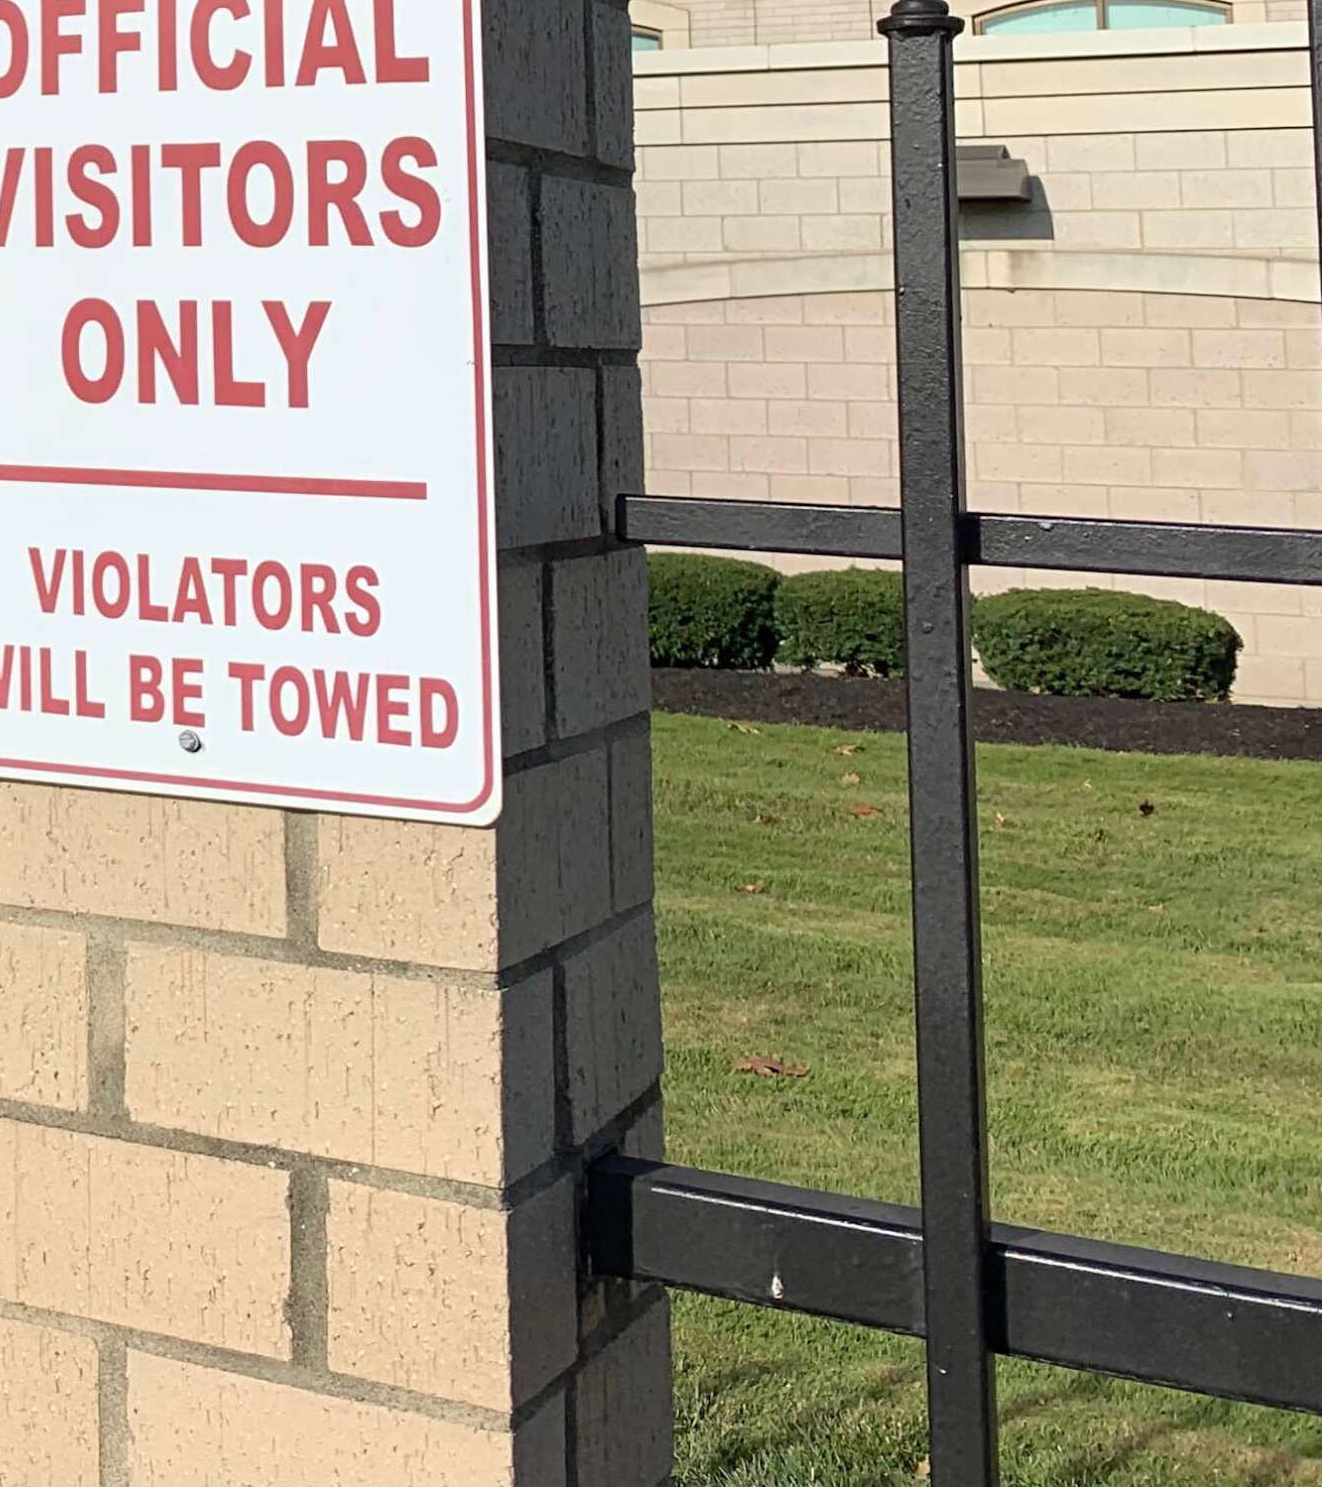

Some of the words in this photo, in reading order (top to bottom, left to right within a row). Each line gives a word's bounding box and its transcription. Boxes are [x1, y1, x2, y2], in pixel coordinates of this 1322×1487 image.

[61, 298, 330, 408] ONLY
[28, 548, 380, 637] VIOLATORS
[129, 654, 205, 727] BE
[227, 662, 459, 749] TOWED
